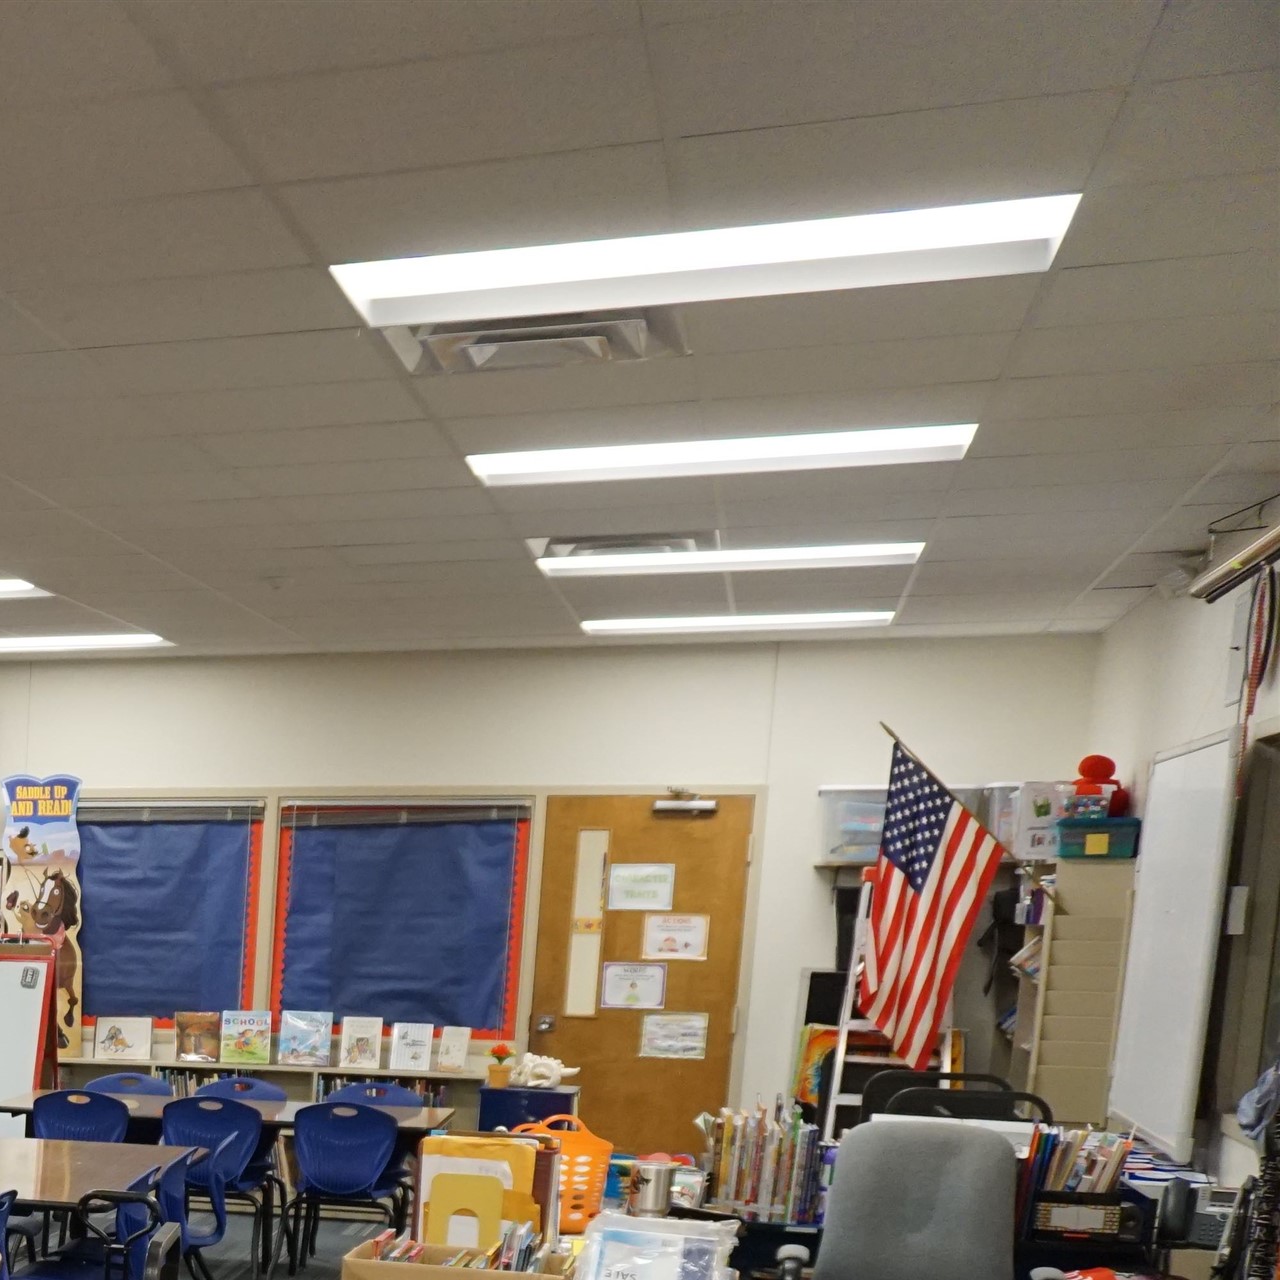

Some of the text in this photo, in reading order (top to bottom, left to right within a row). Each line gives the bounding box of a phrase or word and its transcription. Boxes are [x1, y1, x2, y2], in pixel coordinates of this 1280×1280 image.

[16, 785, 68, 799] SADDLE UP
[11, 799, 73, 816] AND READ!
[223, 1017, 270, 1026] SCHOOL
